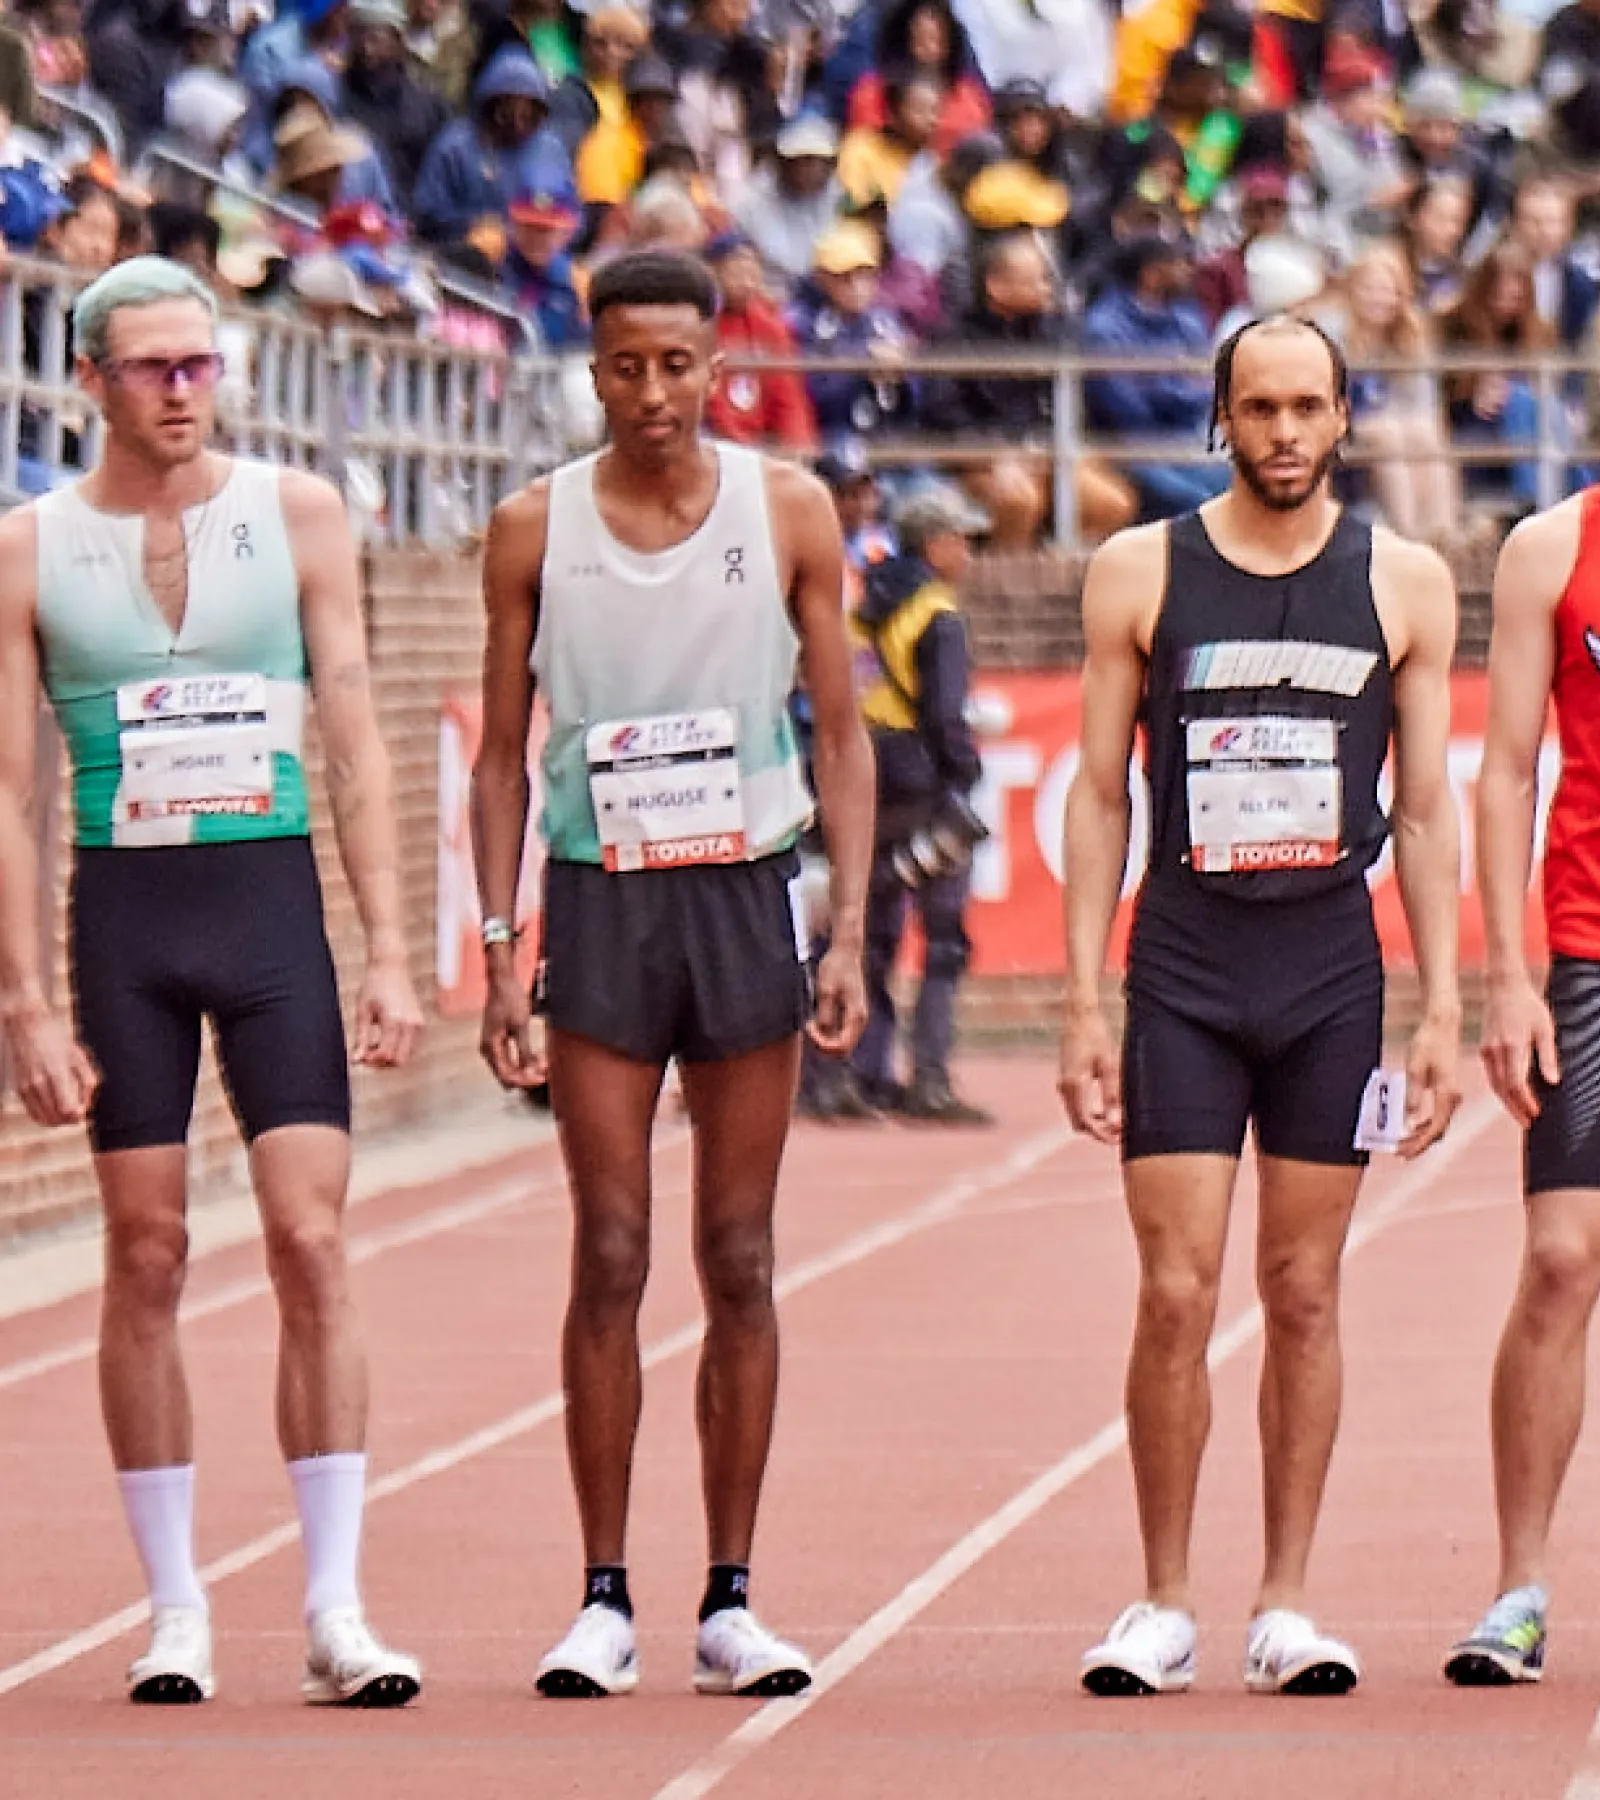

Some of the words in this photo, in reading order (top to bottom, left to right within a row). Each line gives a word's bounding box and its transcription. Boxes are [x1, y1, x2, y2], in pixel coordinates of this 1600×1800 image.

[627, 786, 707, 811] NUGUSE
[643, 836, 734, 863] TOYOTA
[1235, 844, 1323, 867] TOYOTA
